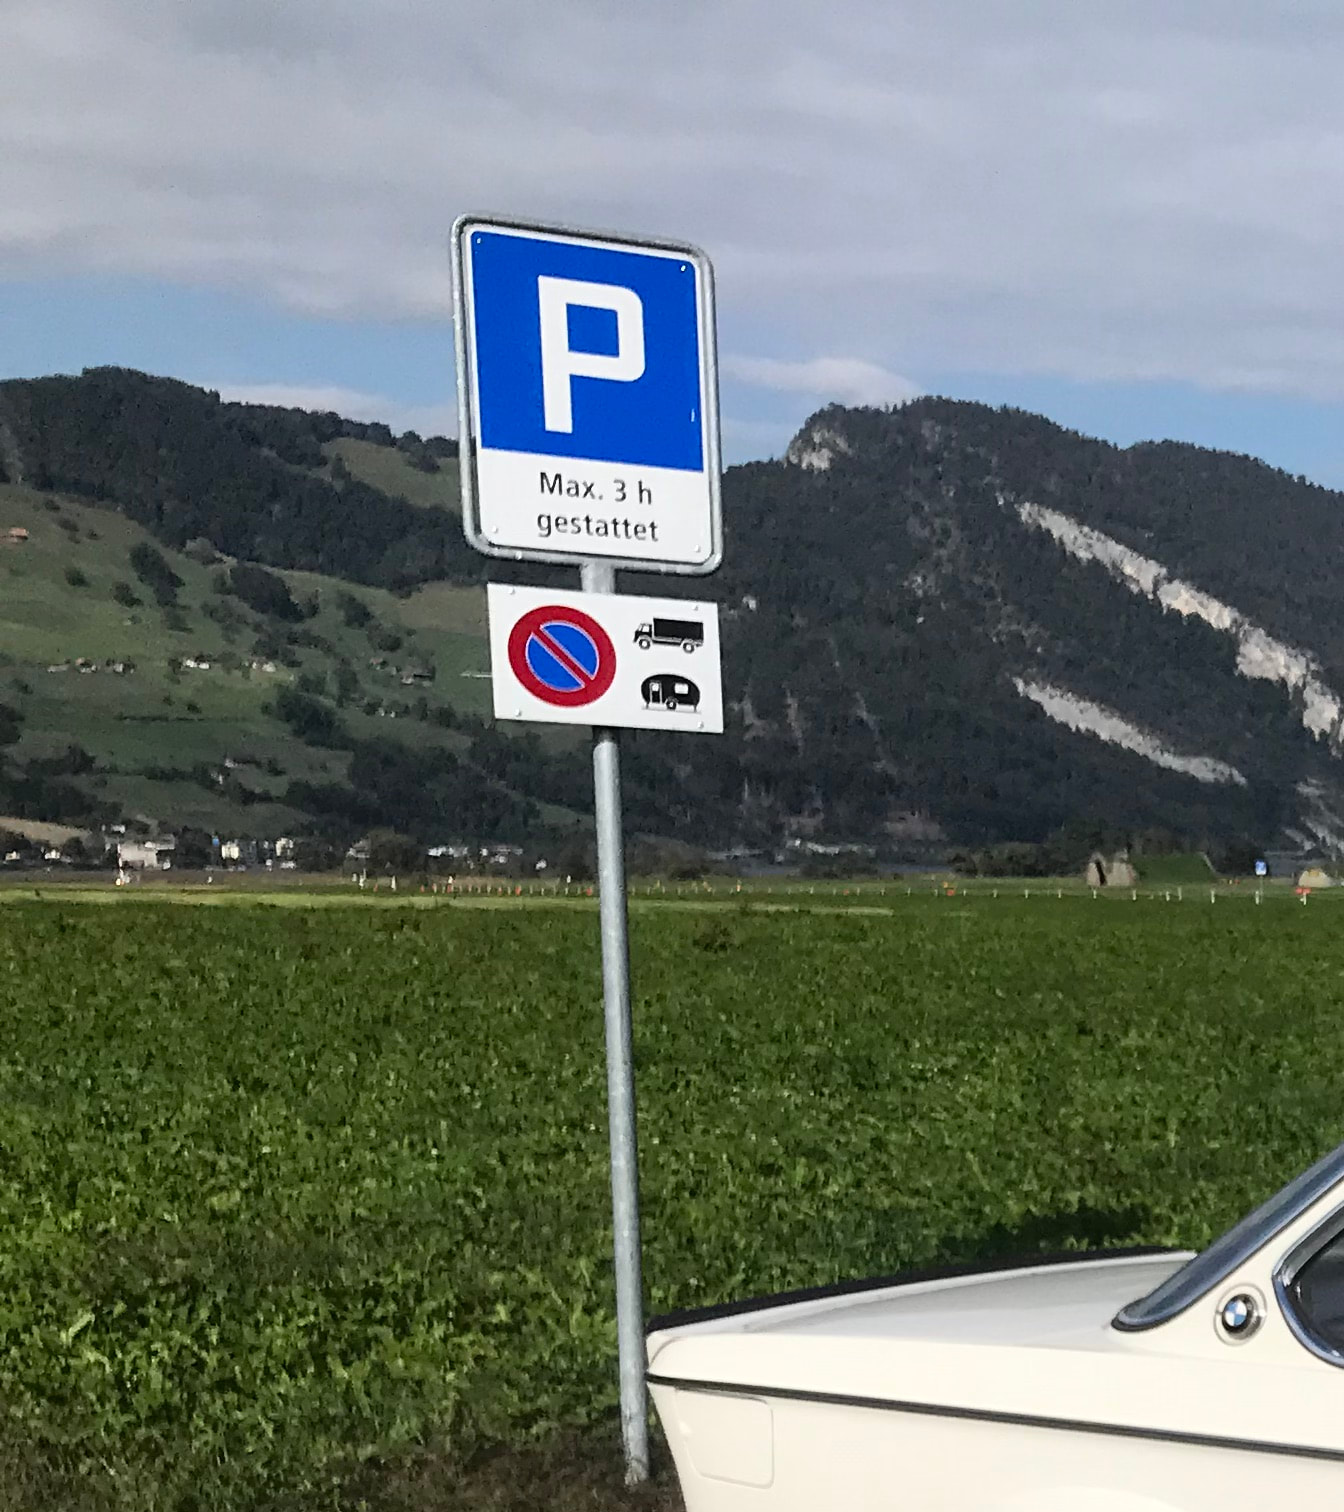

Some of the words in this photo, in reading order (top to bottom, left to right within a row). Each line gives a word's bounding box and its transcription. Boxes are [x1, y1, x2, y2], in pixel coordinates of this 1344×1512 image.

[538, 275, 646, 434] P
[540, 472, 603, 500] Max.
[613, 479, 627, 502] 3
[638, 480, 652, 505] h
[537, 514, 659, 542] gestattet
